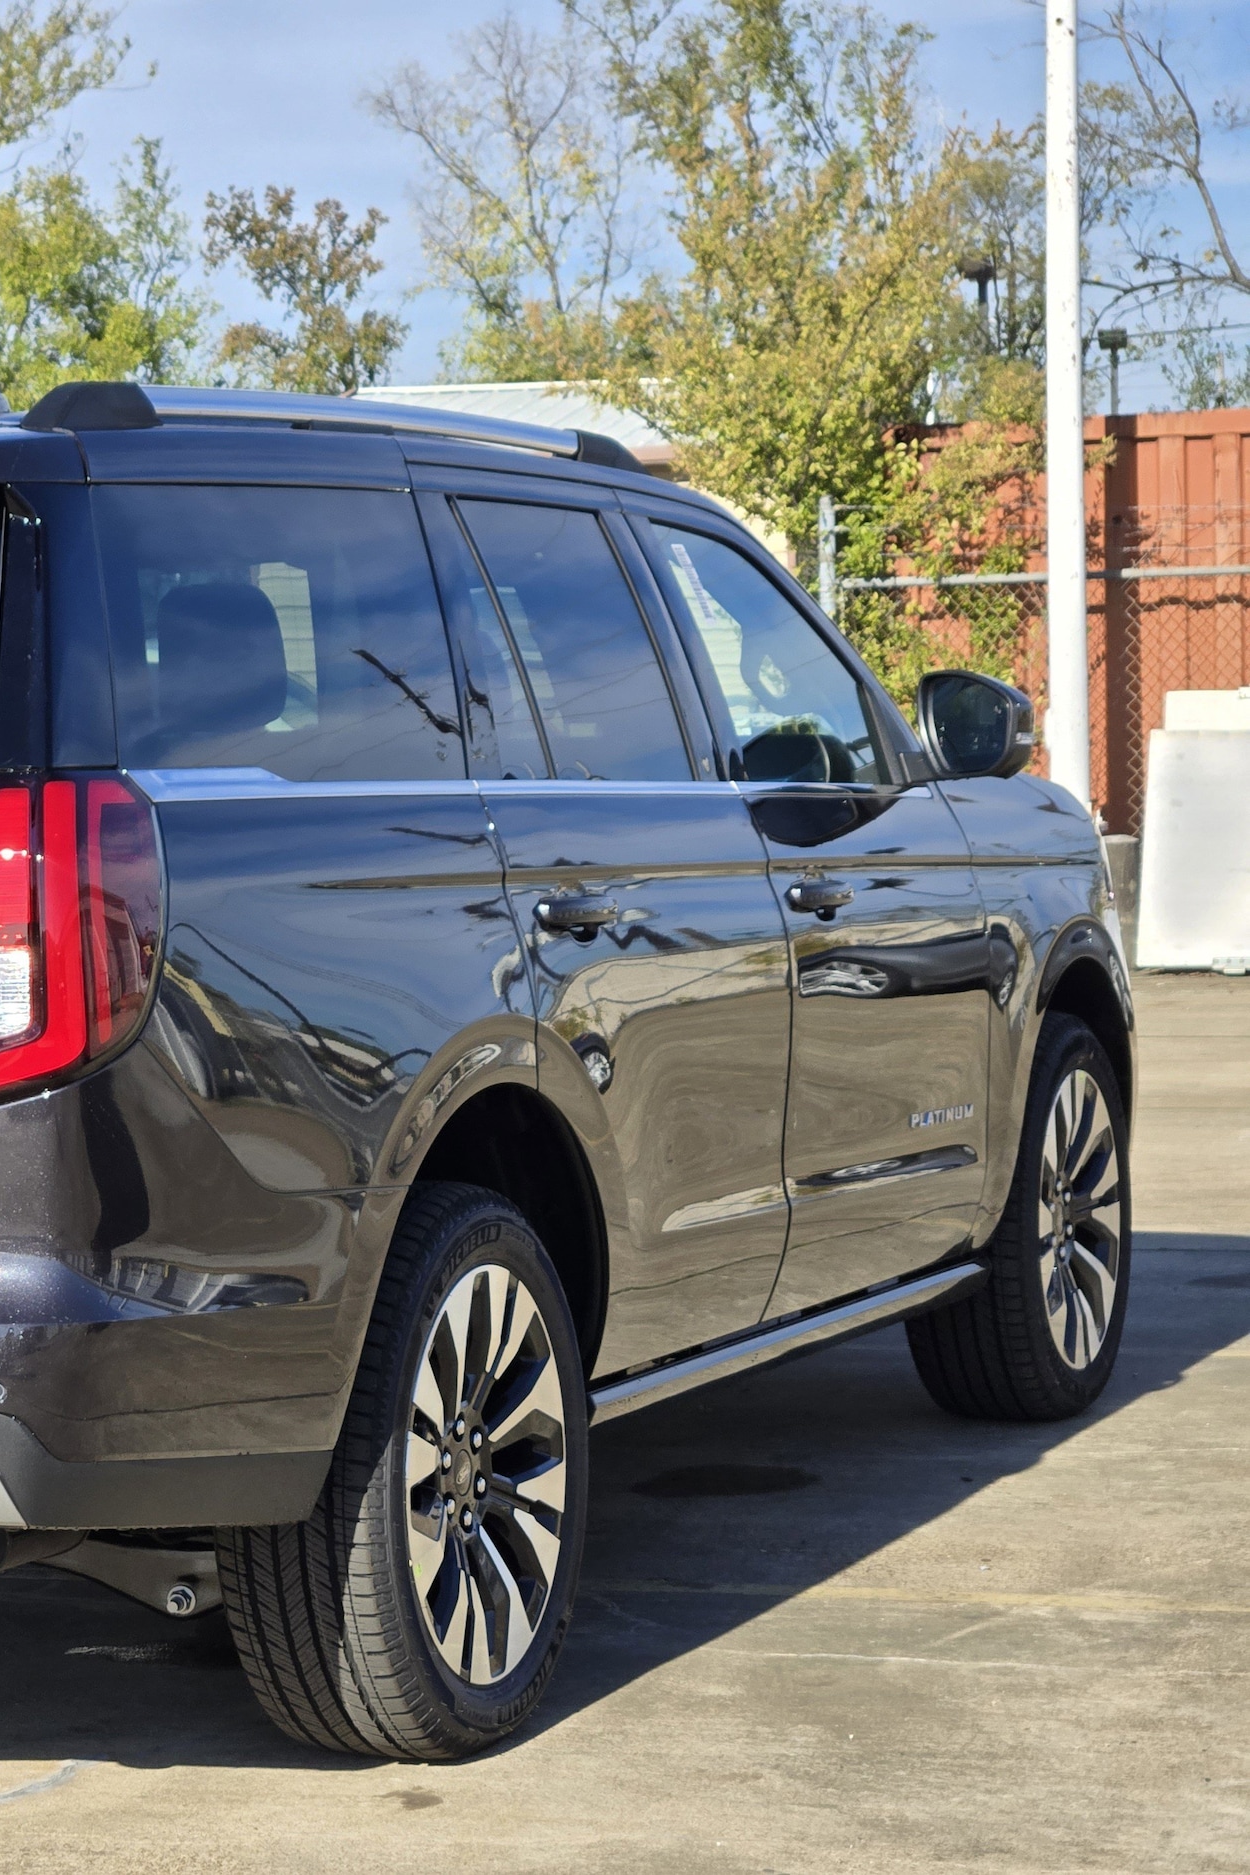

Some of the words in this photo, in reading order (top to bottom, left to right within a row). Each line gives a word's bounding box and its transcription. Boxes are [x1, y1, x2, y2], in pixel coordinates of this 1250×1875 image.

[910, 1104, 974, 1129] PLATINUM
[441, 1225, 498, 1289] MICHELIN
[500, 1649, 554, 1722] MICHELIN
